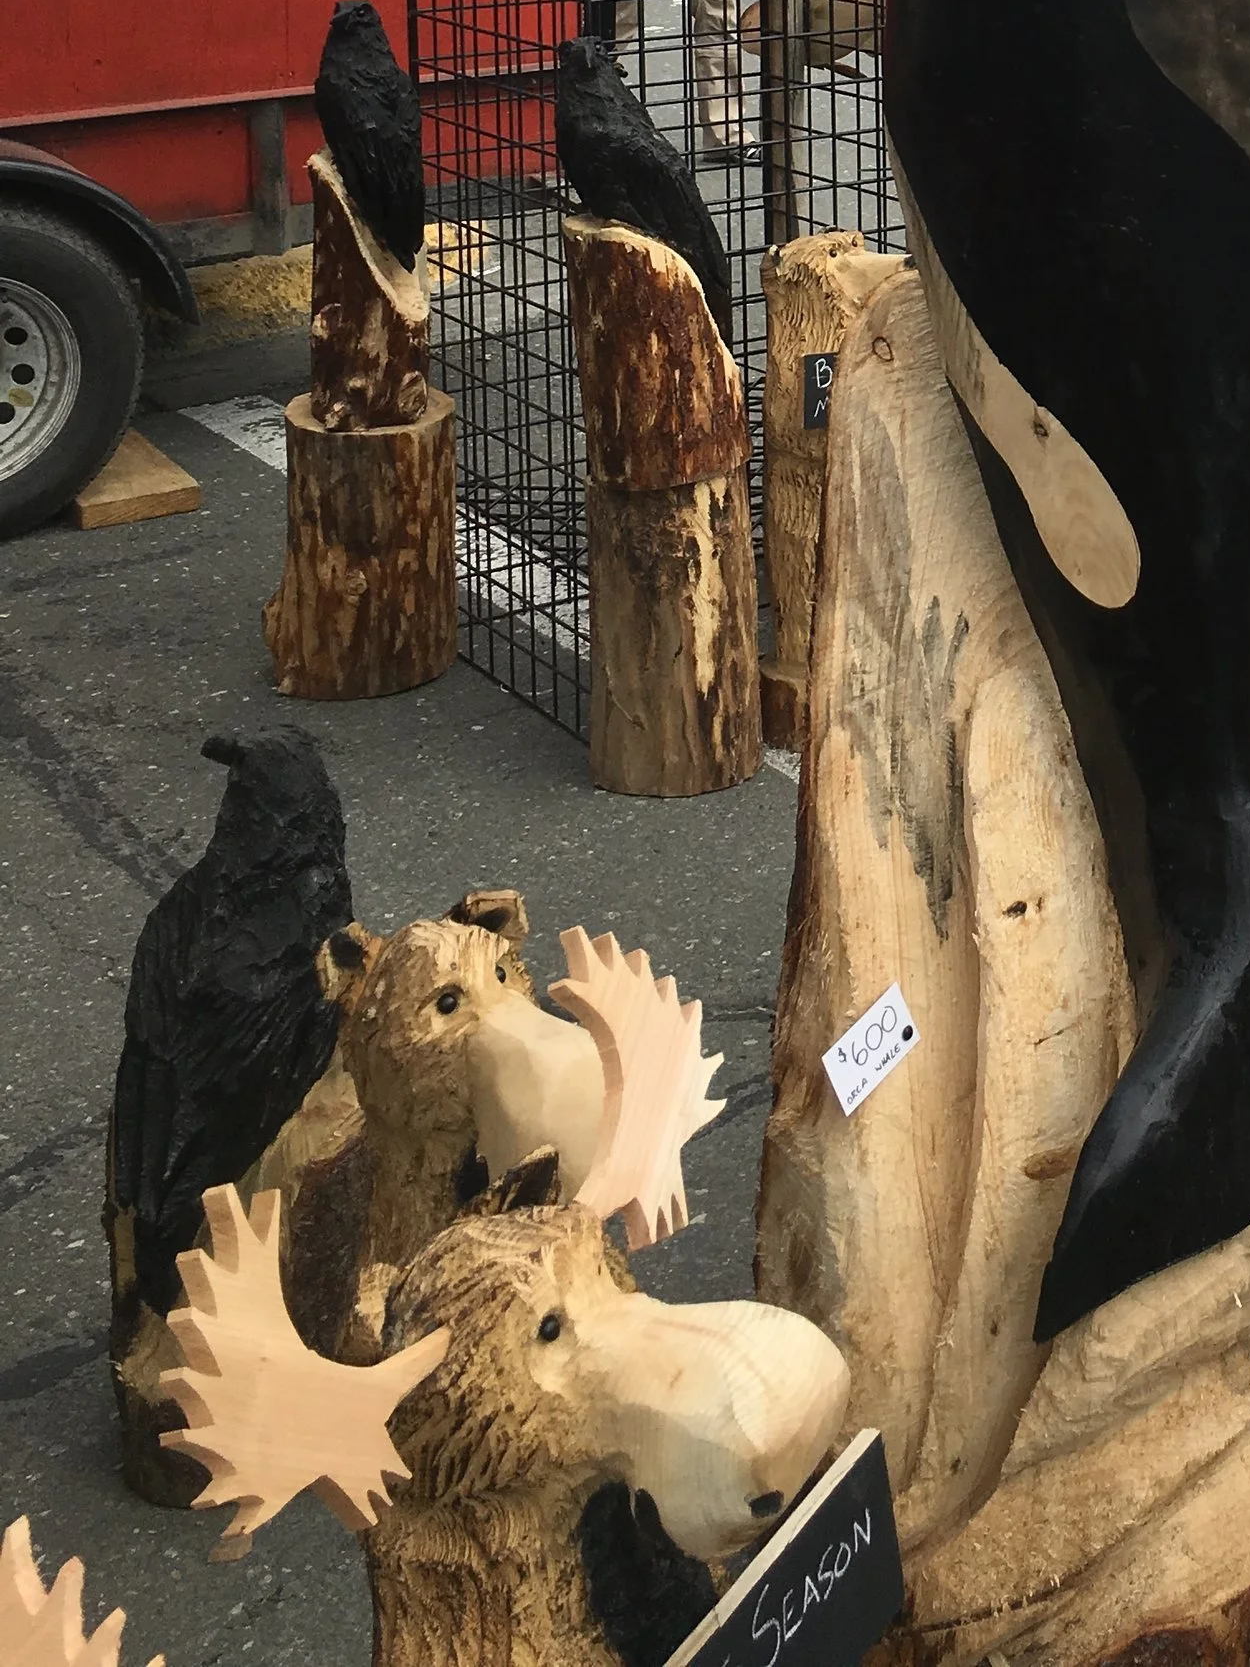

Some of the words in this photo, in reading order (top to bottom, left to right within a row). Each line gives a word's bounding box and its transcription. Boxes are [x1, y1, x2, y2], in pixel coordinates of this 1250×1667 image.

[837, 1005, 898, 1067] $600
[846, 1077, 869, 1105] ORCA
[874, 1042, 901, 1073] WHALE
[752, 1507, 872, 1667] SEASON
